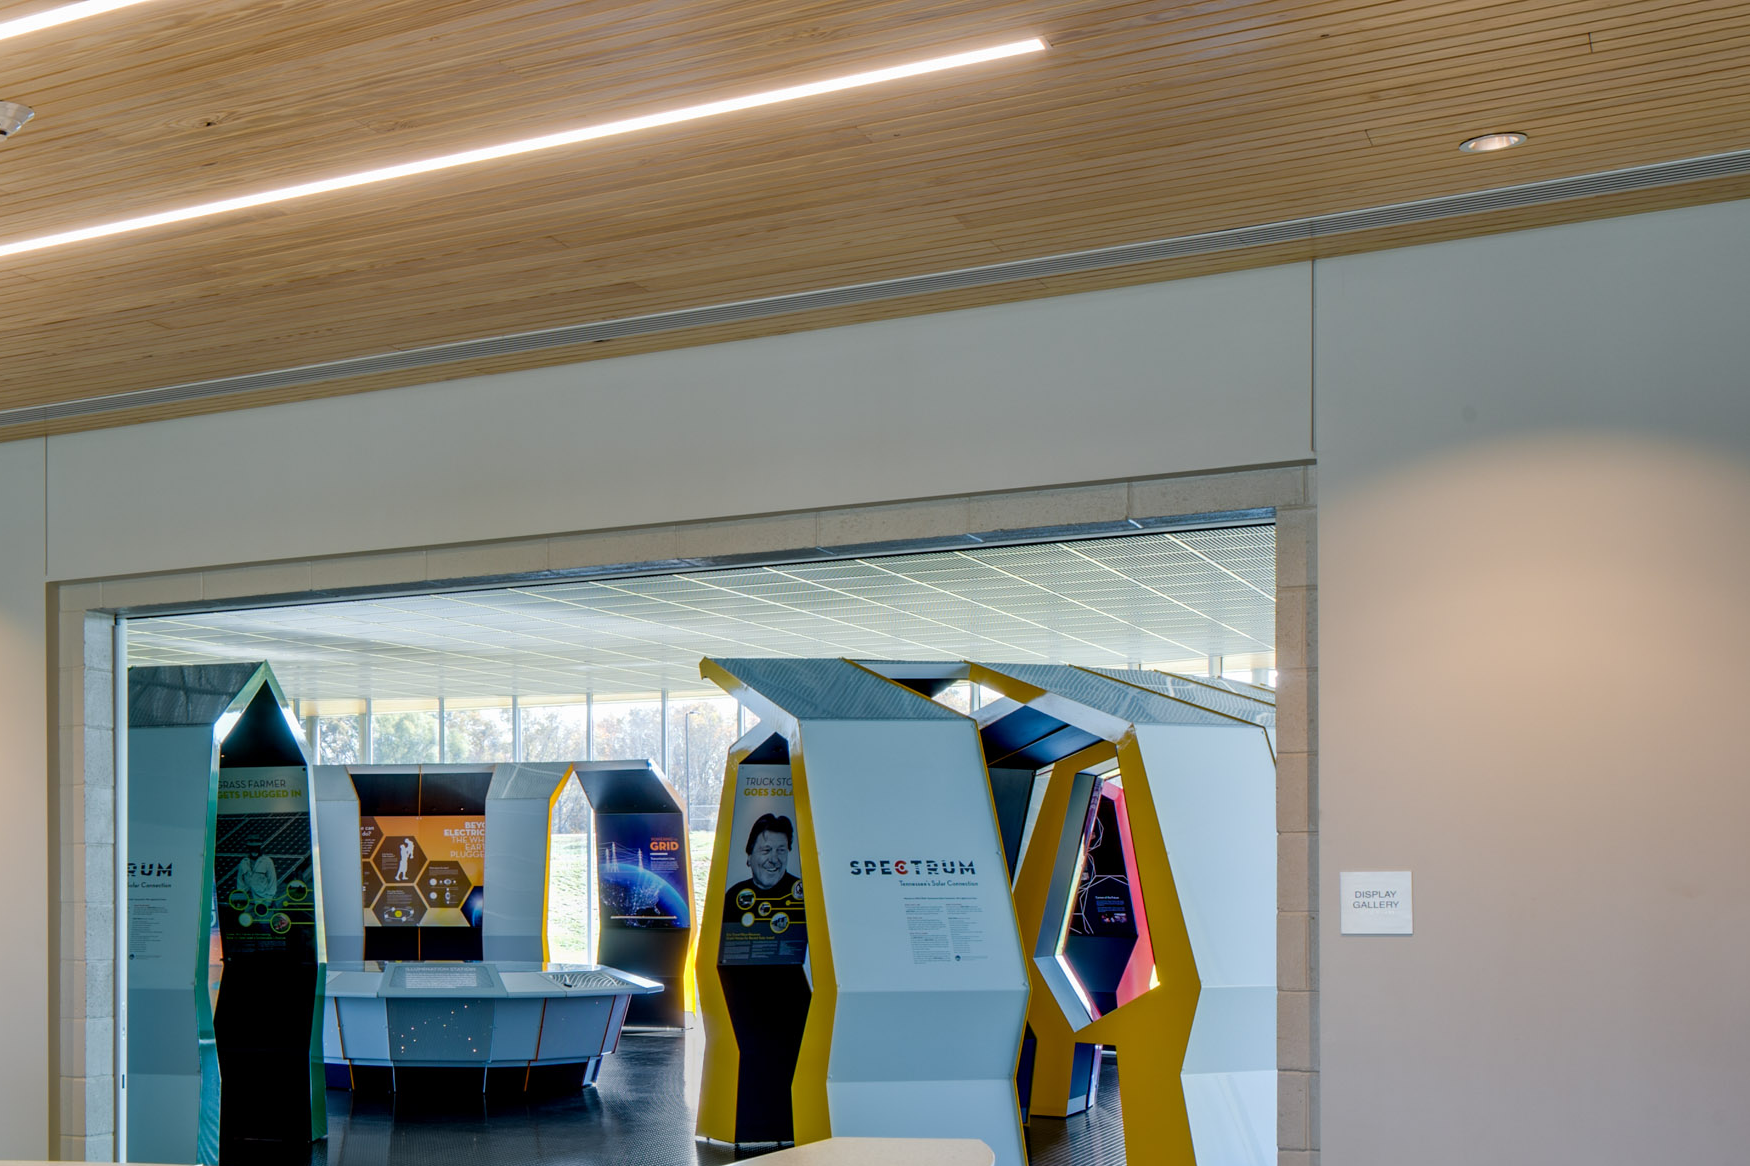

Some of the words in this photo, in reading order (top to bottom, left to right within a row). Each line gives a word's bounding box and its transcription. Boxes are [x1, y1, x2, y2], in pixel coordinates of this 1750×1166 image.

[248, 779, 286, 788] FARMER
[746, 777, 775, 786] TRUCK
[242, 789, 289, 799] PLUGGED
[291, 788, 302, 798] IN
[744, 788, 769, 797] GOES
[650, 841, 679, 851] GRID
[850, 859, 976, 875] SPECTRUM
[947, 879, 979, 887] Connection
[1354, 890, 1397, 899] DISPLAY
[1352, 900, 1400, 909] GALLERY
